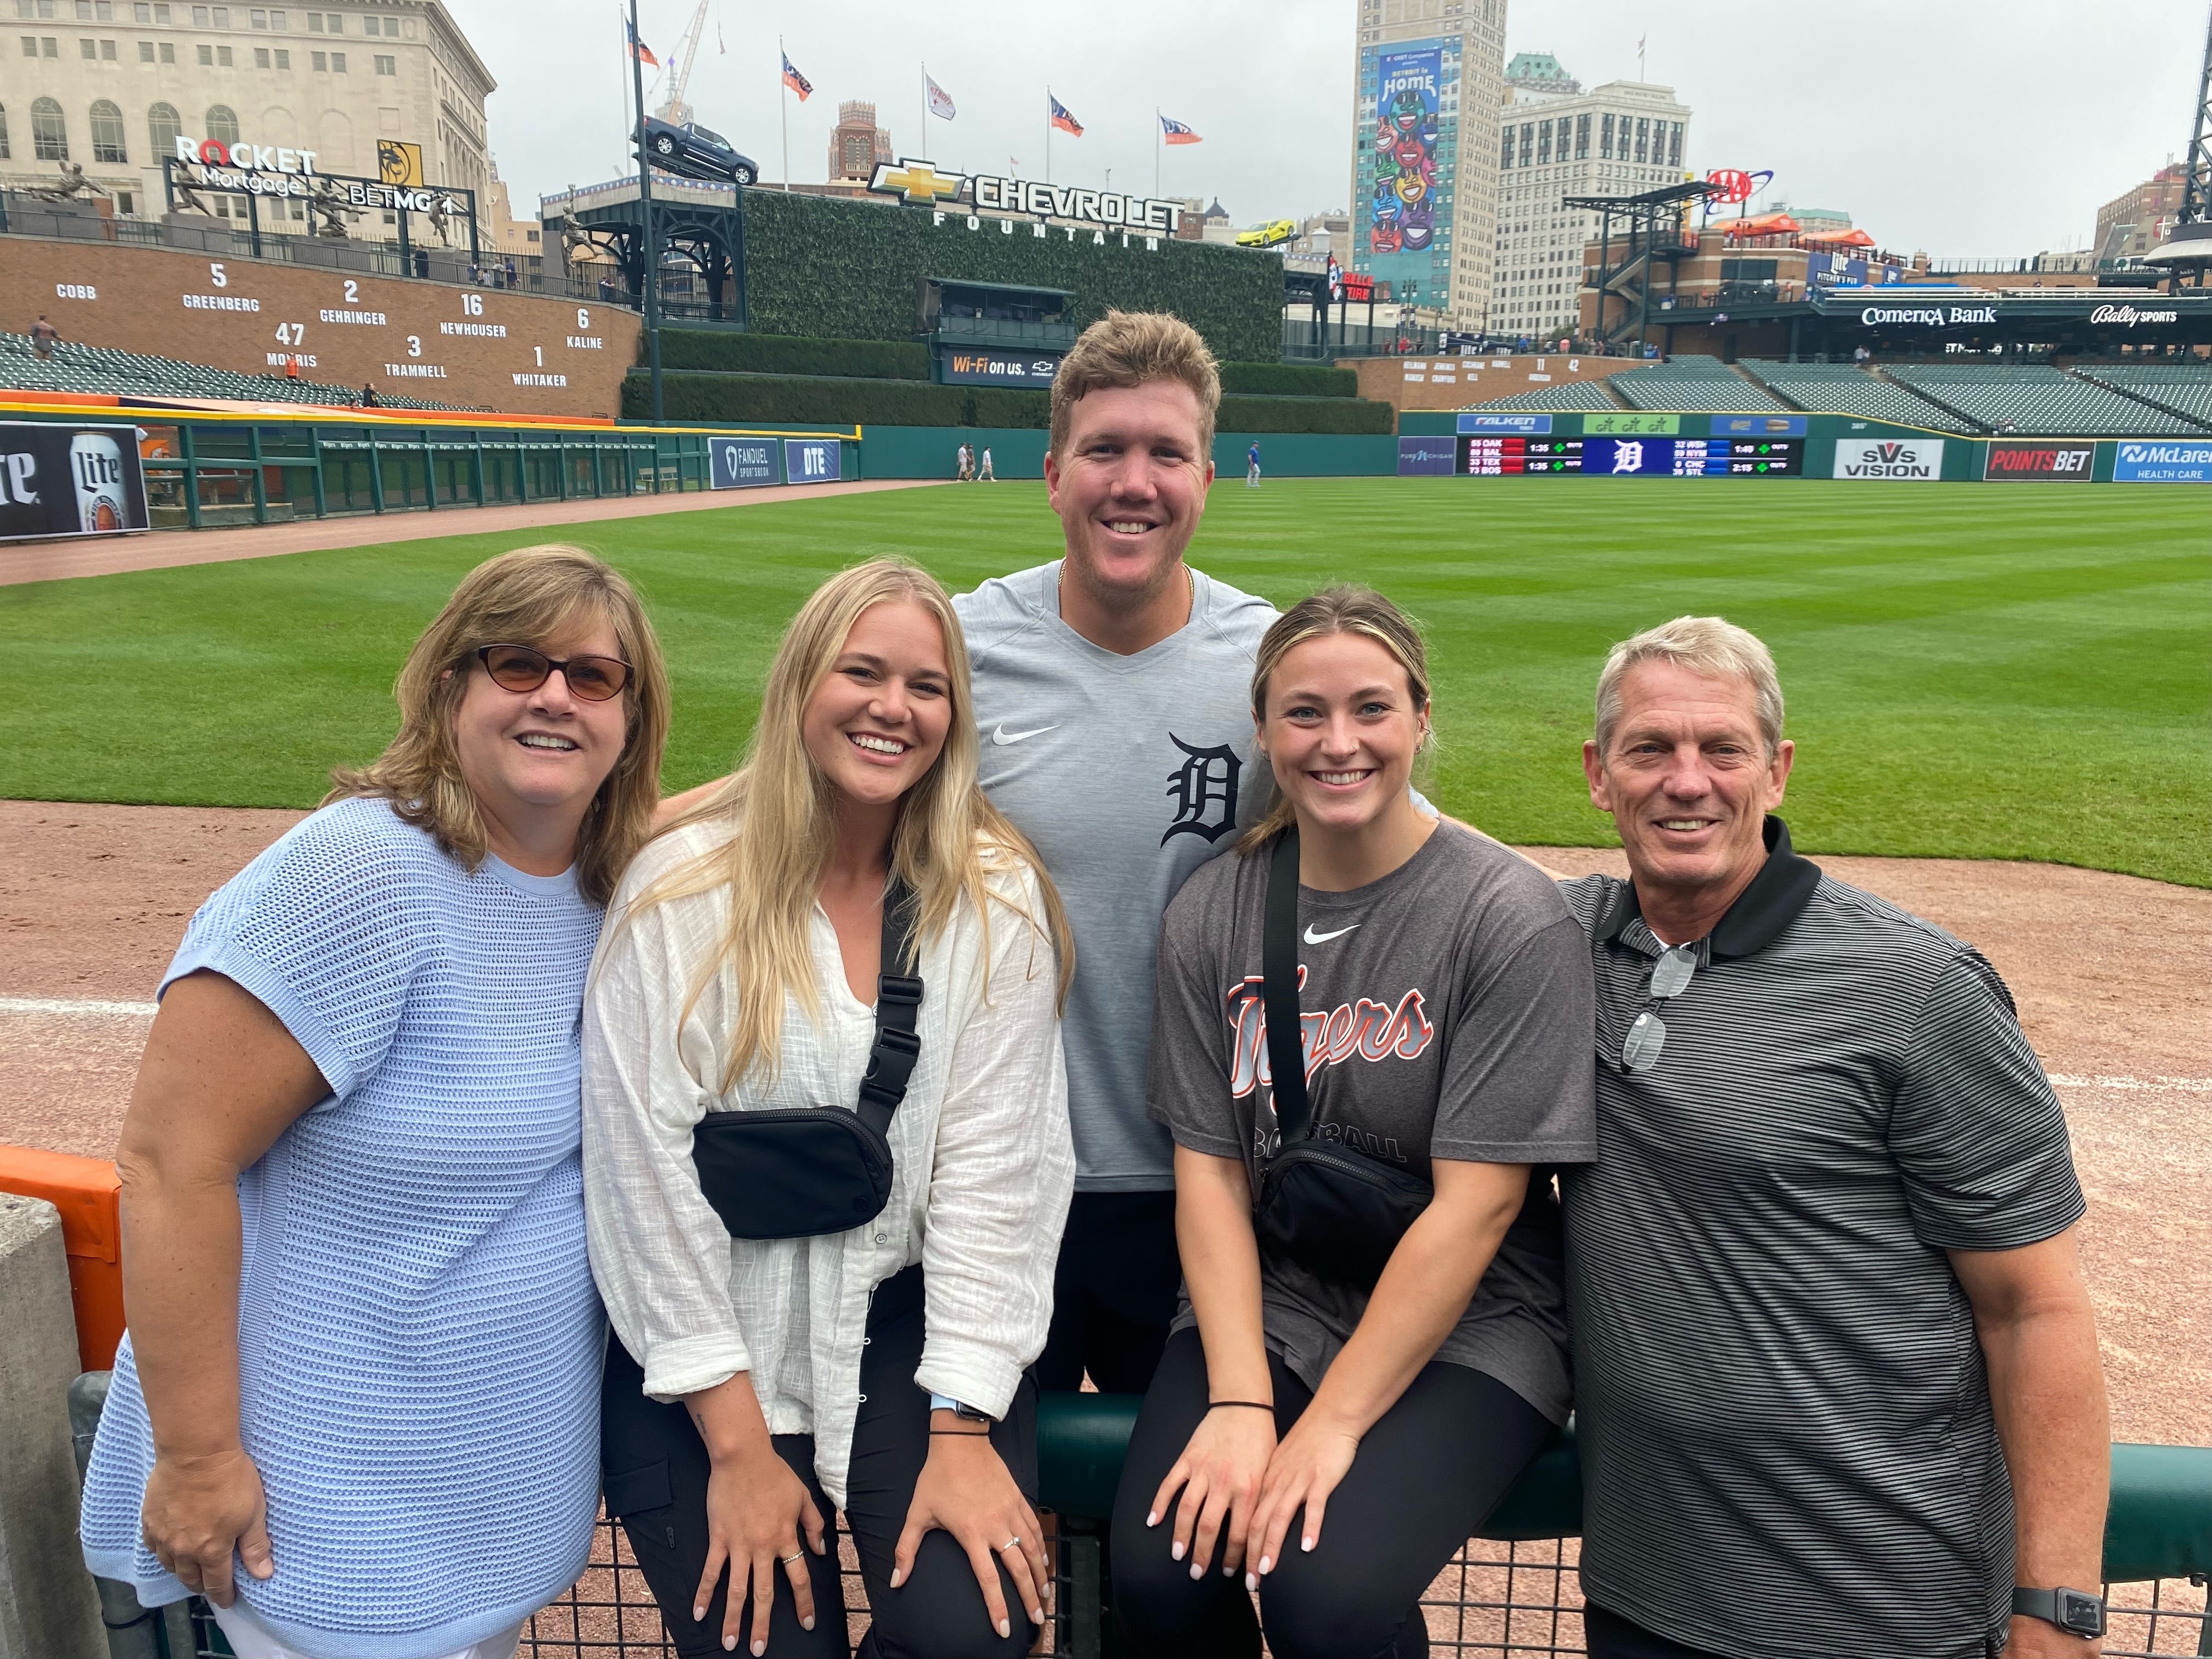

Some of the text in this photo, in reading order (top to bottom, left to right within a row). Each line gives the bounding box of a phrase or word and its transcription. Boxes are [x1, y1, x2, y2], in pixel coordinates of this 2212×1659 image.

[175, 136, 317, 176] ROCKET
[200, 167, 300, 198] Mortgage
[974, 175, 1185, 231] CHEVROLET
[934, 211, 1158, 251] FOUNTAIN
[210, 263, 228, 288] 5
[1342, 271, 1374, 285] BELLE
[56, 284, 97, 300] COBB
[343, 280, 358, 303] 2
[1346, 286, 1370, 300] TIRE
[182, 294, 259, 312] GREENBERG
[460, 294, 483, 316] 16
[319, 309, 386, 325] GEHRINGER
[577, 308, 589, 329] 6
[1949, 307, 1998, 323] Bank
[2091, 304, 2177, 328] Bally SPORTS
[275, 322, 304, 346] 47
[440, 321, 506, 337] NEWHOUSER
[407, 335, 421, 357] 3
[566, 335, 602, 349] KALINE
[533, 346, 543, 366] 1
[953, 356, 1025, 376] Wi-Fi on us.
[385, 363, 447, 378] TRAMMELL
[512, 373, 567, 387] WHITAKER
[738, 447, 768, 465] FANDUEL
[803, 447, 826, 476] DTE
[1990, 450, 2091, 471] POINTSBET
[1844, 465, 1930, 477] VISION
[2137, 470, 2203, 479] HEALTH CARE
[1254, 1121, 1407, 1163] BABALL
